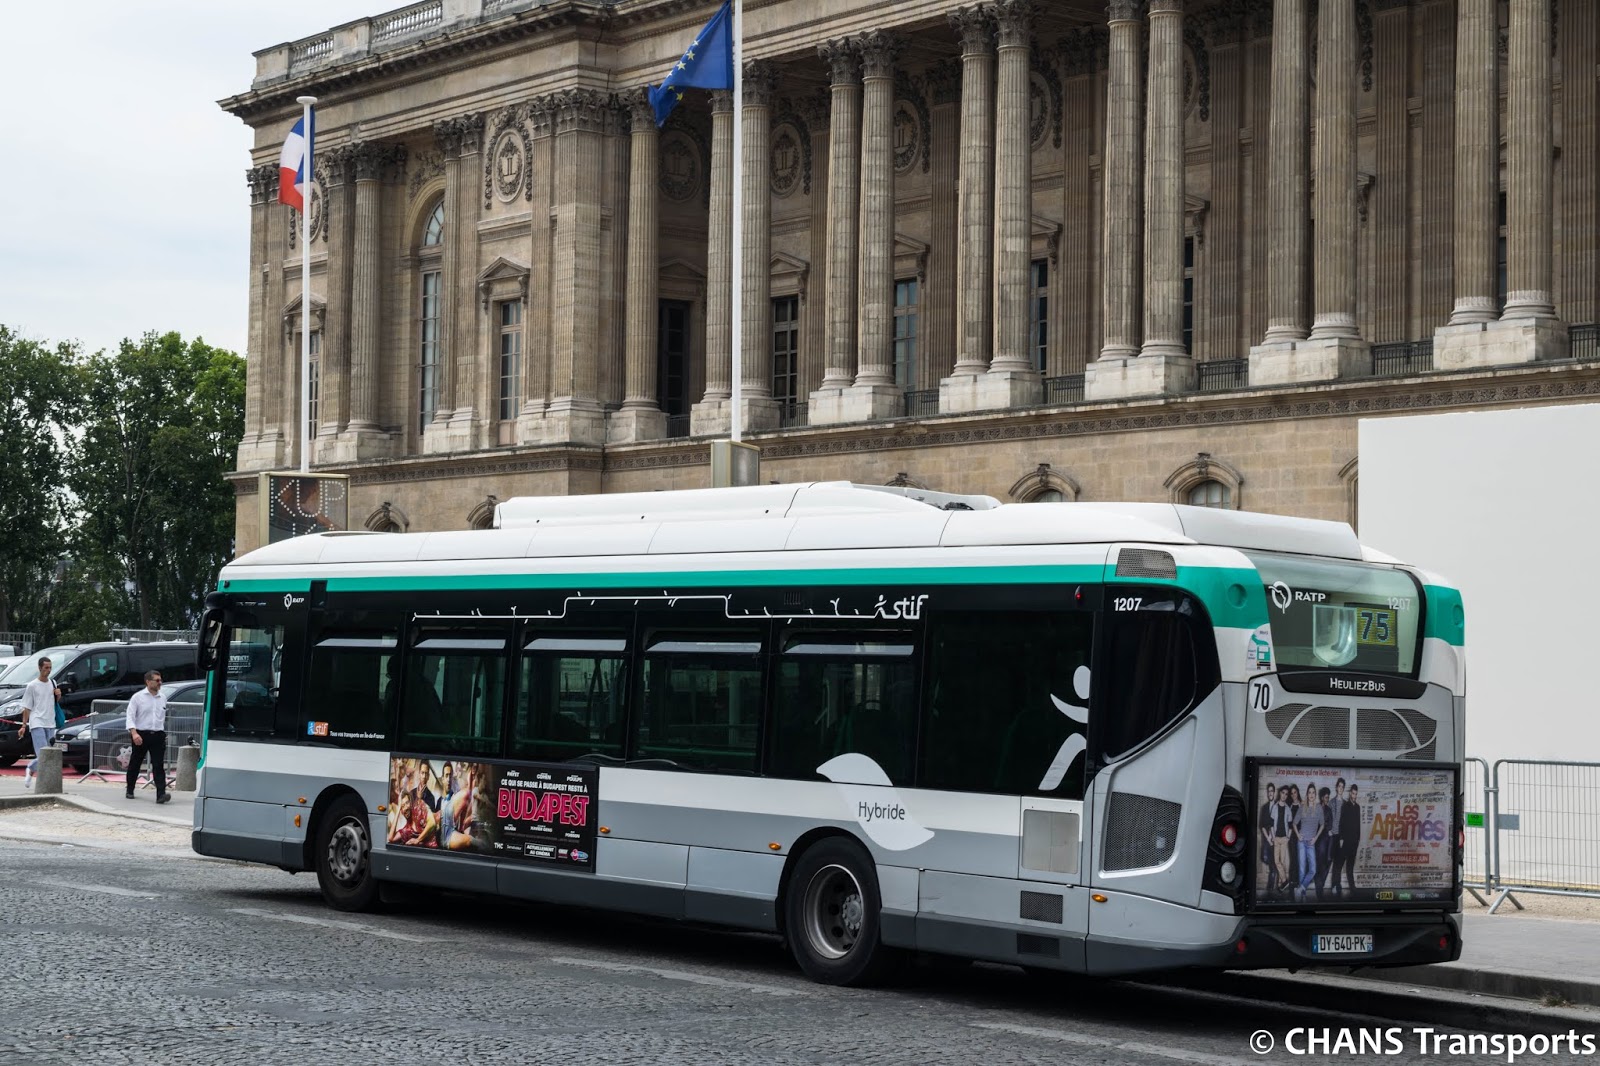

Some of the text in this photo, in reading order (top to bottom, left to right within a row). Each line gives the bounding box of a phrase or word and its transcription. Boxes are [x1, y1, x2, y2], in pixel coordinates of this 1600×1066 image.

[1295, 591, 1326, 602] RATP
[1113, 598, 1142, 611] 1207
[1387, 598, 1411, 610] 1207
[1361, 612, 1389, 642] 75
[1330, 678, 1386, 692] HEULIEZBUS
[1254, 683, 1270, 710] 70
[315, 723, 329, 735] stif
[538, 781, 542, 789] À
[543, 782, 567, 791] BUDAPEST
[584, 785, 588, 793] À
[497, 788, 590, 826] BUDAPEST
[858, 801, 905, 821] Hybride
[1397, 800, 1419, 820] Les
[1369, 812, 1445, 841] Affamés
[526, 844, 554, 852] ACTUELLEMENT
[1320, 936, 1365, 951] DY-640-PK
